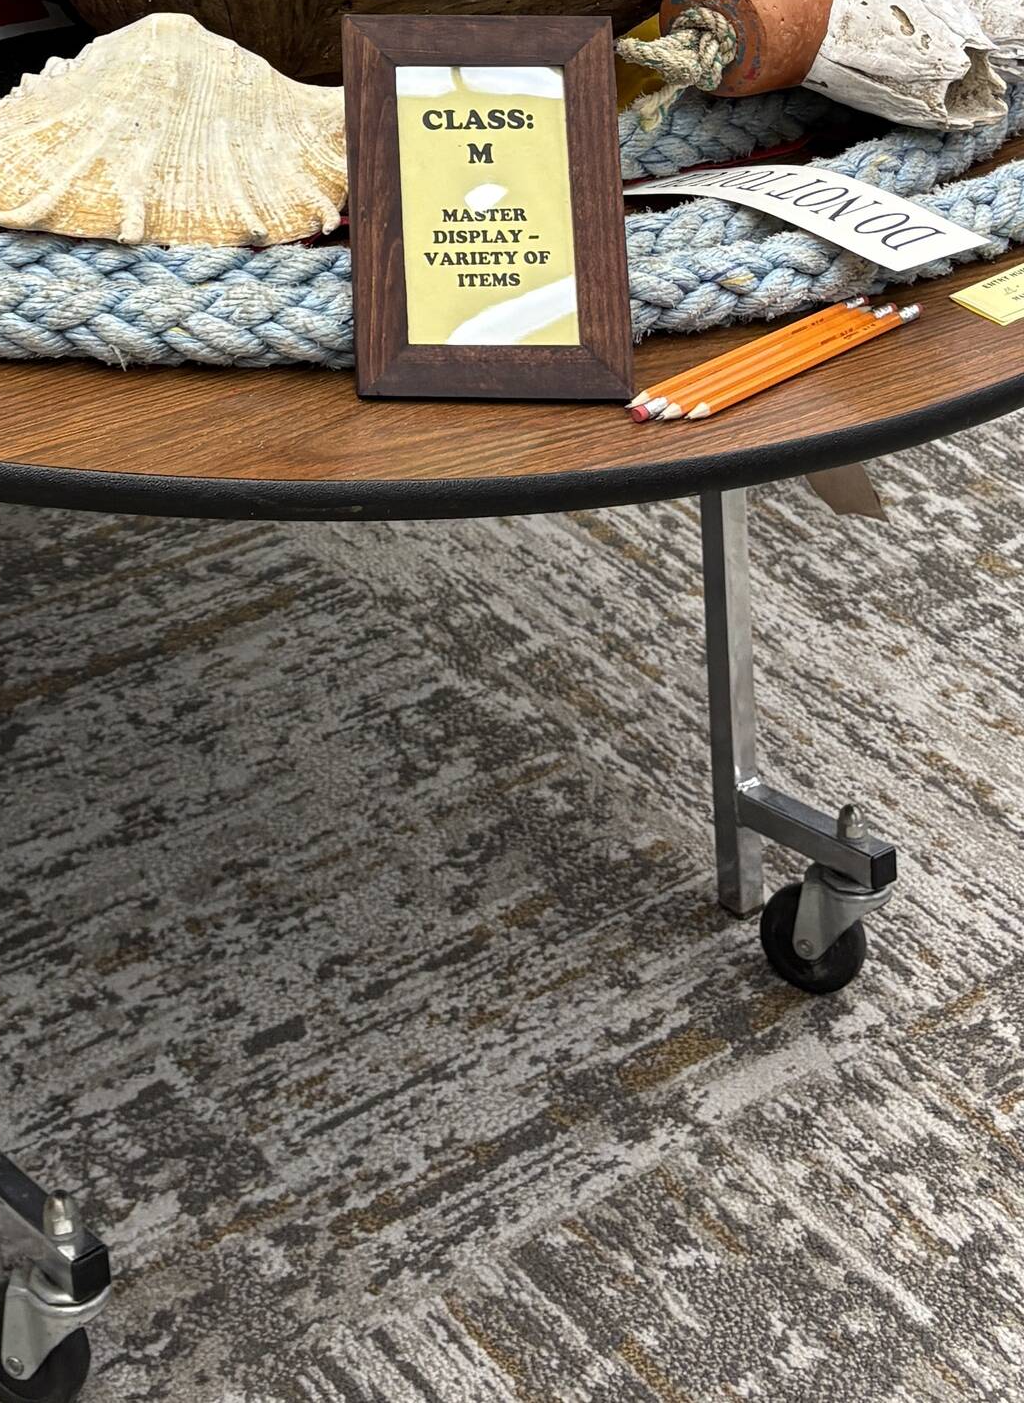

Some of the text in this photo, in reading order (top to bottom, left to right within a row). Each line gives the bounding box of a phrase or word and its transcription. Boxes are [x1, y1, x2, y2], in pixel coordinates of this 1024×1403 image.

[422, 109, 534, 130] CLASS:
[467, 143, 494, 164] M
[765, 178, 882, 221] NOT
[442, 208, 527, 222] MASTER
[433, 229, 523, 244] DISPLAY
[854, 212, 946, 251] DO
[424, 251, 551, 266] VARIETY OF
[457, 272, 521, 287] ITEMS
